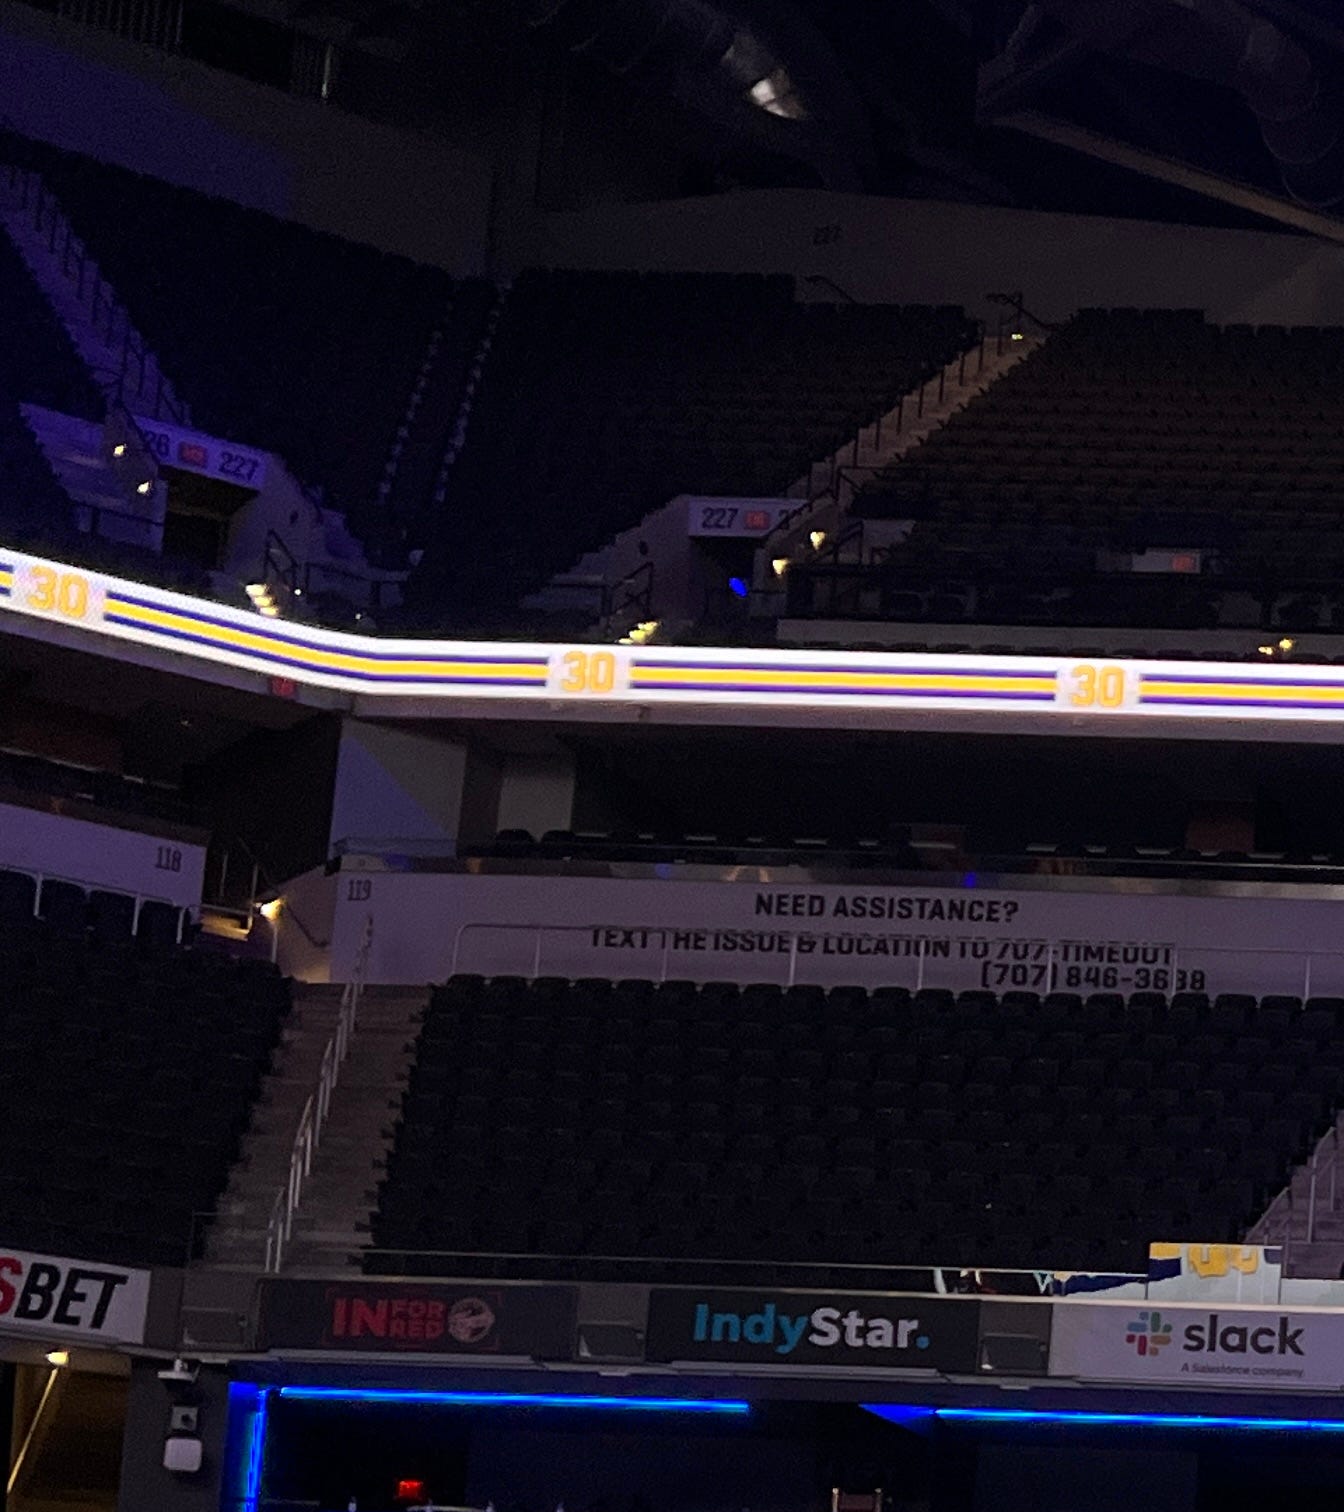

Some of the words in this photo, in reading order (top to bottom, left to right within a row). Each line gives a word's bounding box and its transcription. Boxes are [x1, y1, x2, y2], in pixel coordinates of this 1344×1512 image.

[218, 452, 258, 480] 227
[702, 508, 738, 529] 227
[27, 564, 90, 619] 30
[561, 651, 616, 693] 30
[1070, 664, 1126, 708] 30
[155, 846, 182, 873] 118
[348, 879, 372, 901] 119
[755, 894, 825, 917] NEED
[833, 896, 1019, 923] ASSISTANCE?
[332, 1298, 388, 1338] IN
[1183, 1314, 1304, 1356] slack
